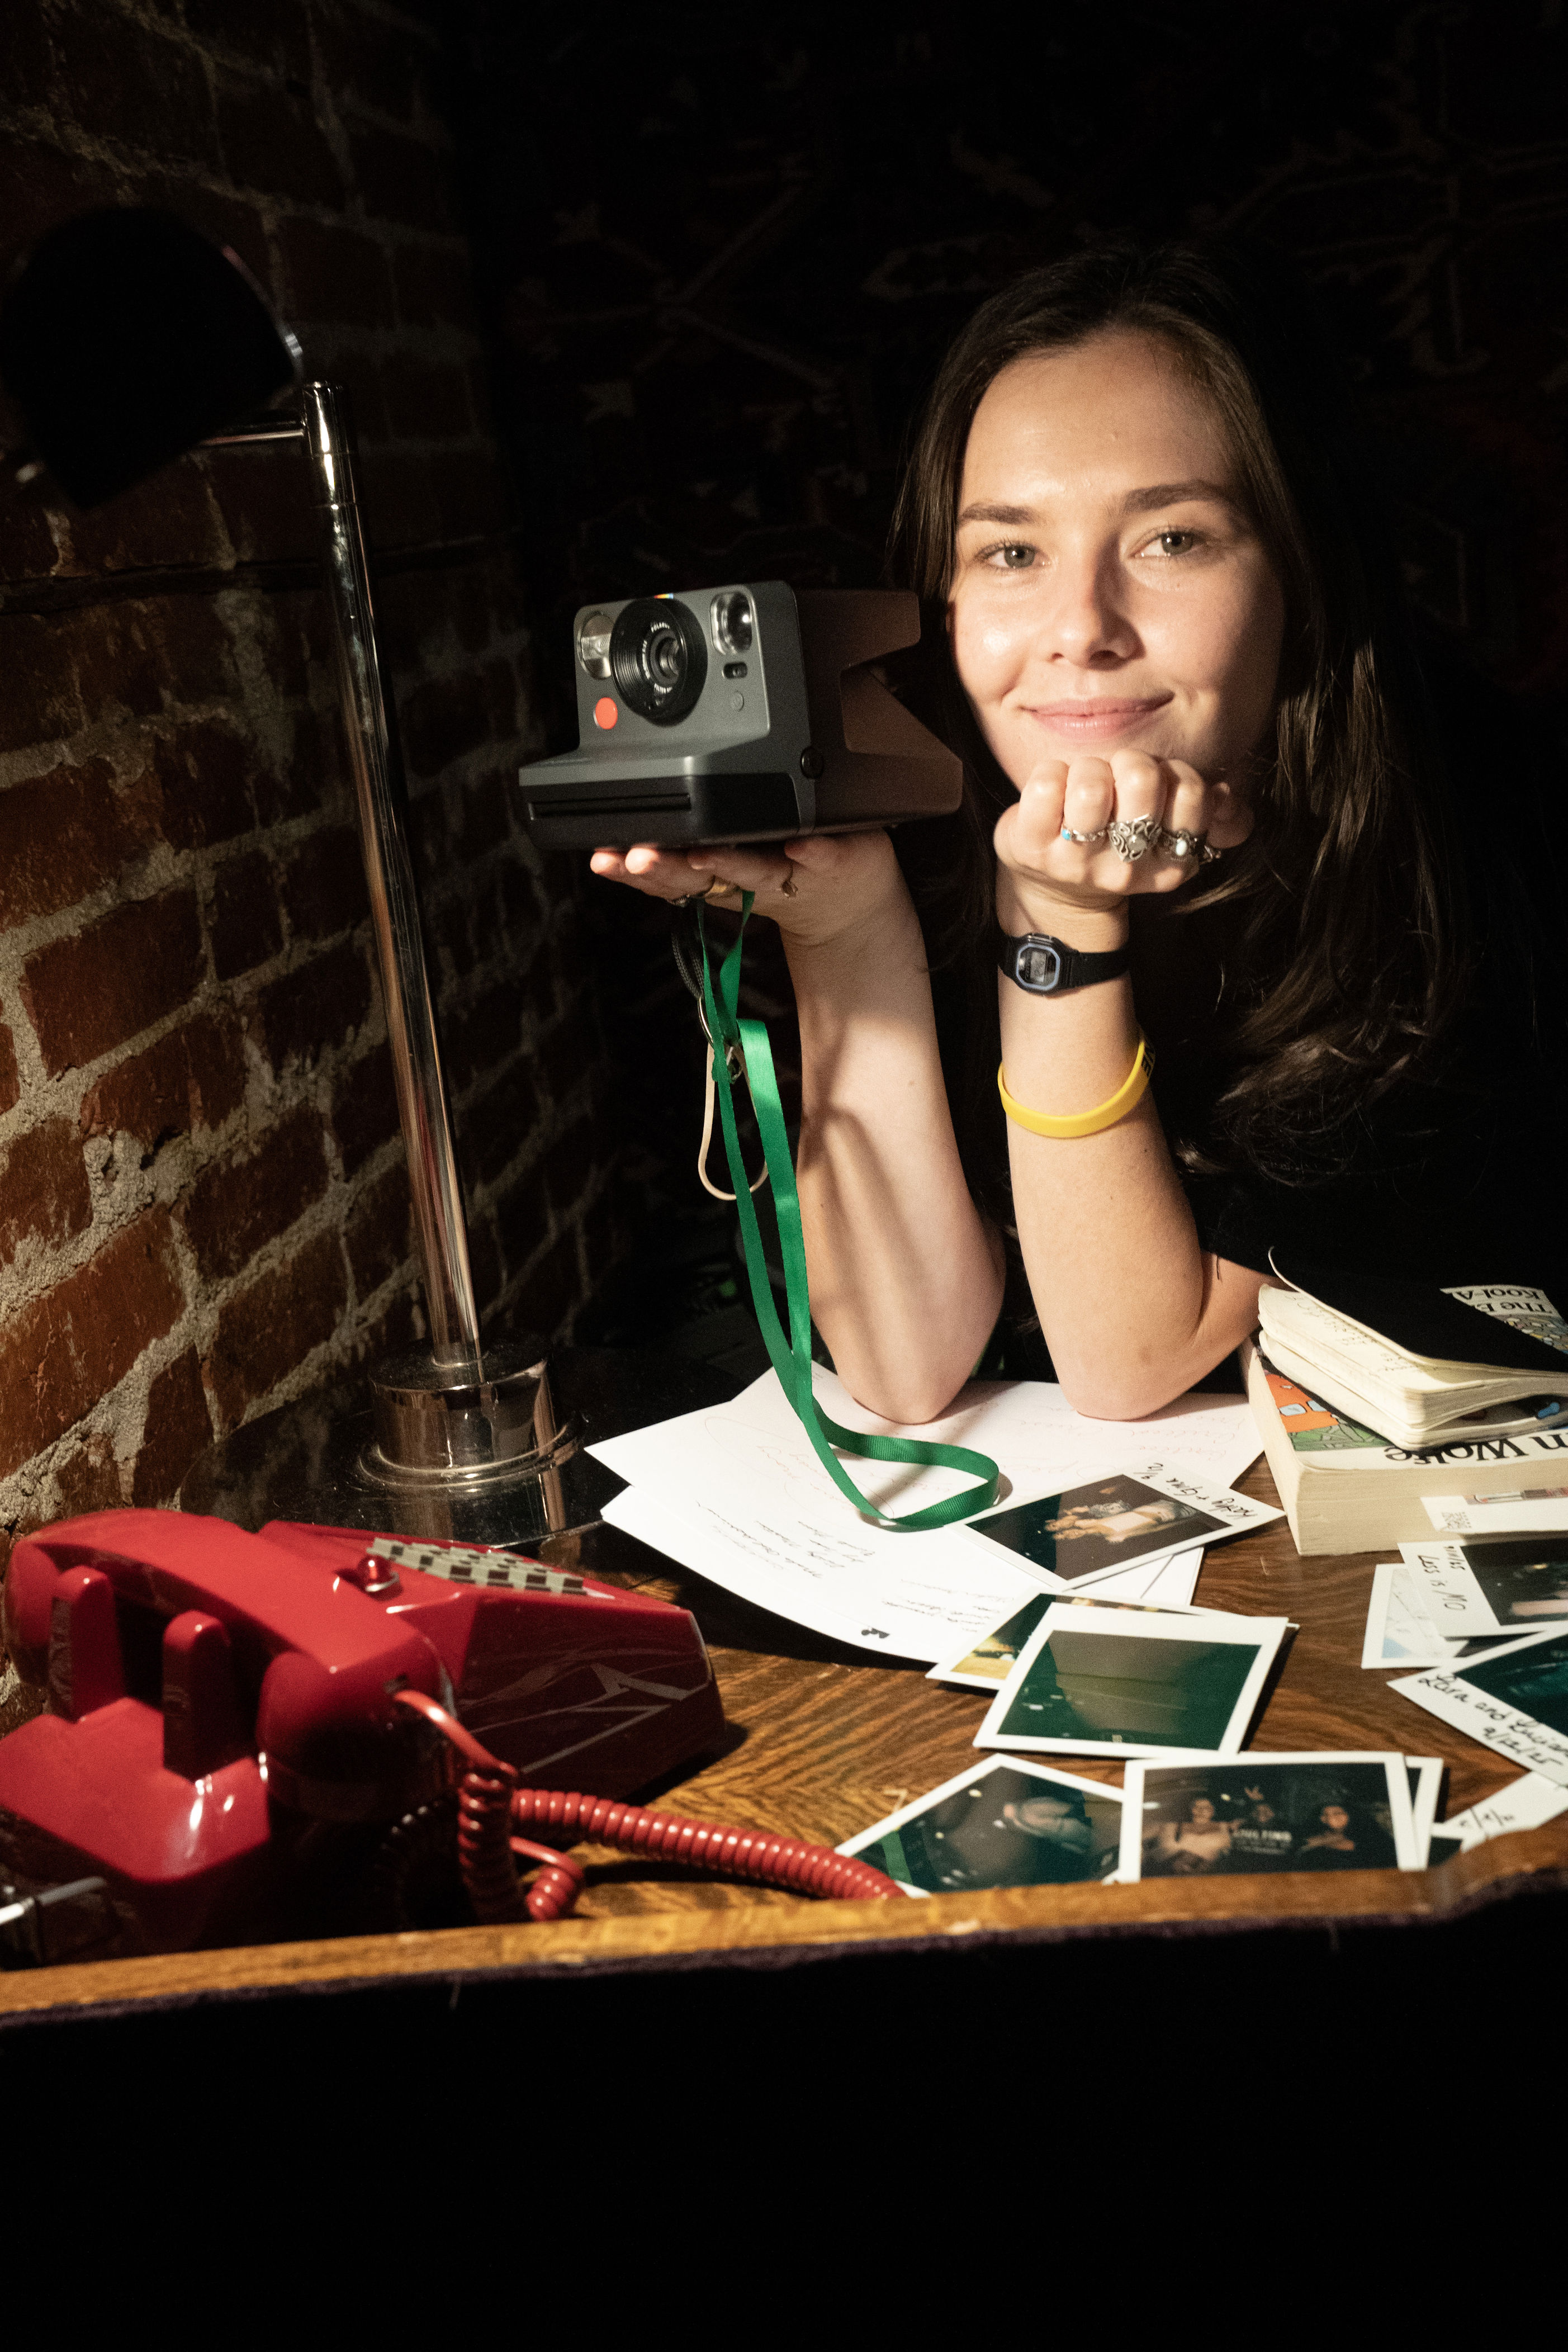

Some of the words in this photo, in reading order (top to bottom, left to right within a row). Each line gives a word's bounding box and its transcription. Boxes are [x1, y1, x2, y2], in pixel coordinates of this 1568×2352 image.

[1500, 1302, 1553, 1314] The
[1418, 1673, 1468, 1703] Lara
[1474, 1701, 1513, 1721] and
